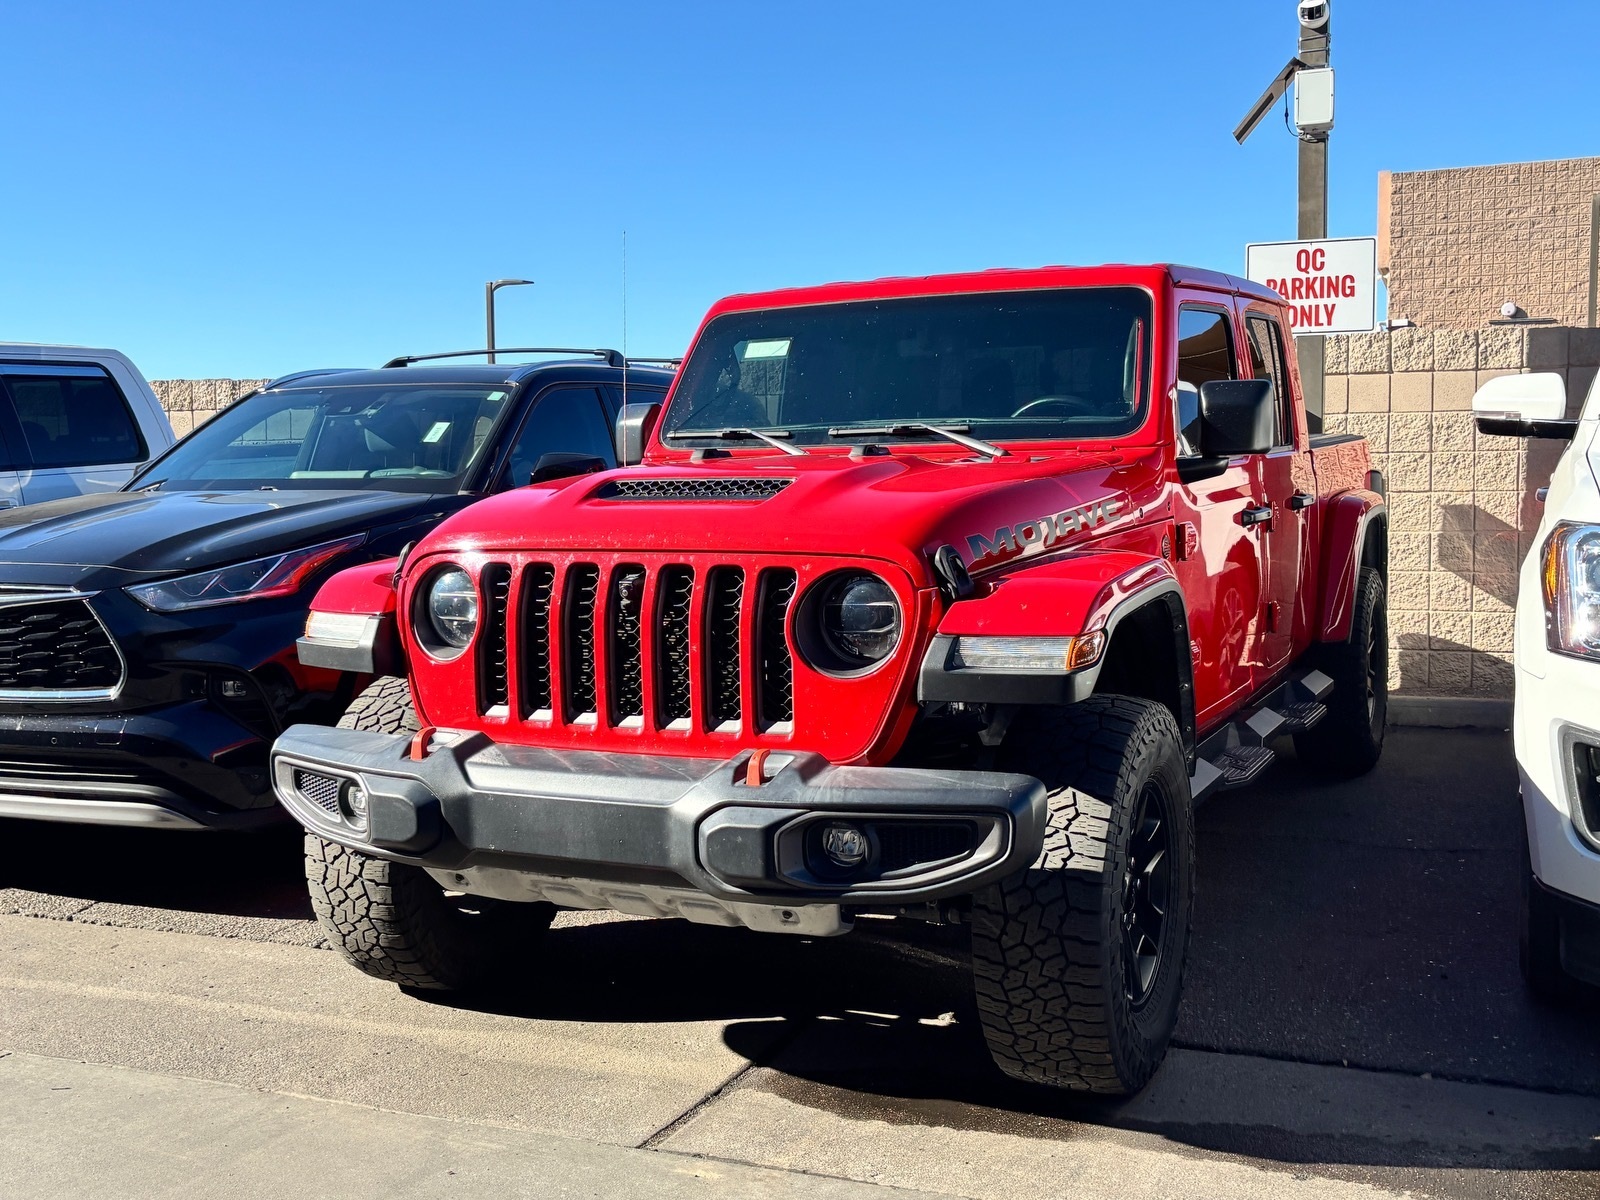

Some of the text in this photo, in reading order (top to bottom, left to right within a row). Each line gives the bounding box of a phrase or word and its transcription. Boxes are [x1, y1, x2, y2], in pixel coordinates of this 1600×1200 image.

[1296, 248, 1325, 274] QC
[1286, 304, 1336, 328] ONLY
[966, 499, 1121, 559] MOJAVE
